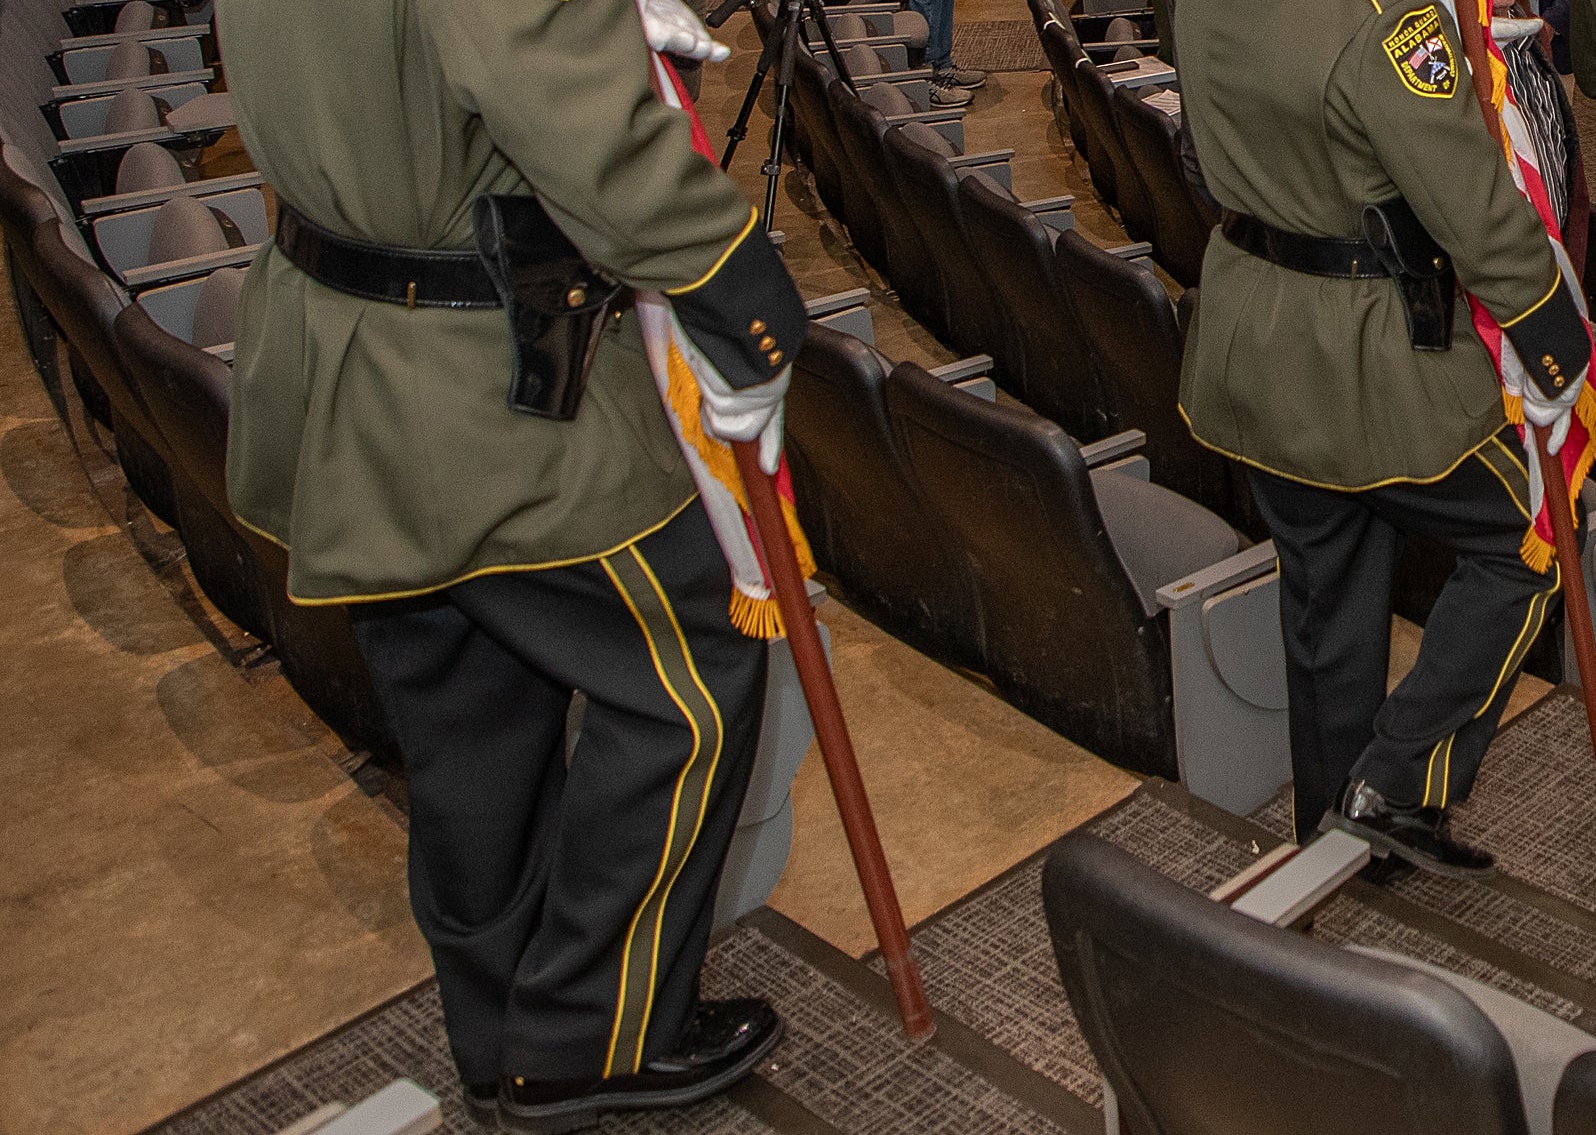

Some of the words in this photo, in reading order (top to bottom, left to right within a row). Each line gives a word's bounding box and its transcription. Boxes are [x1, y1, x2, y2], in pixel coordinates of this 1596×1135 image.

[1388, 26, 1414, 47] HONOR
[1414, 10, 1436, 28] GUARD
[1394, 20, 1440, 59] ALABAMA
[1401, 61, 1437, 92] DEPARTMENT
